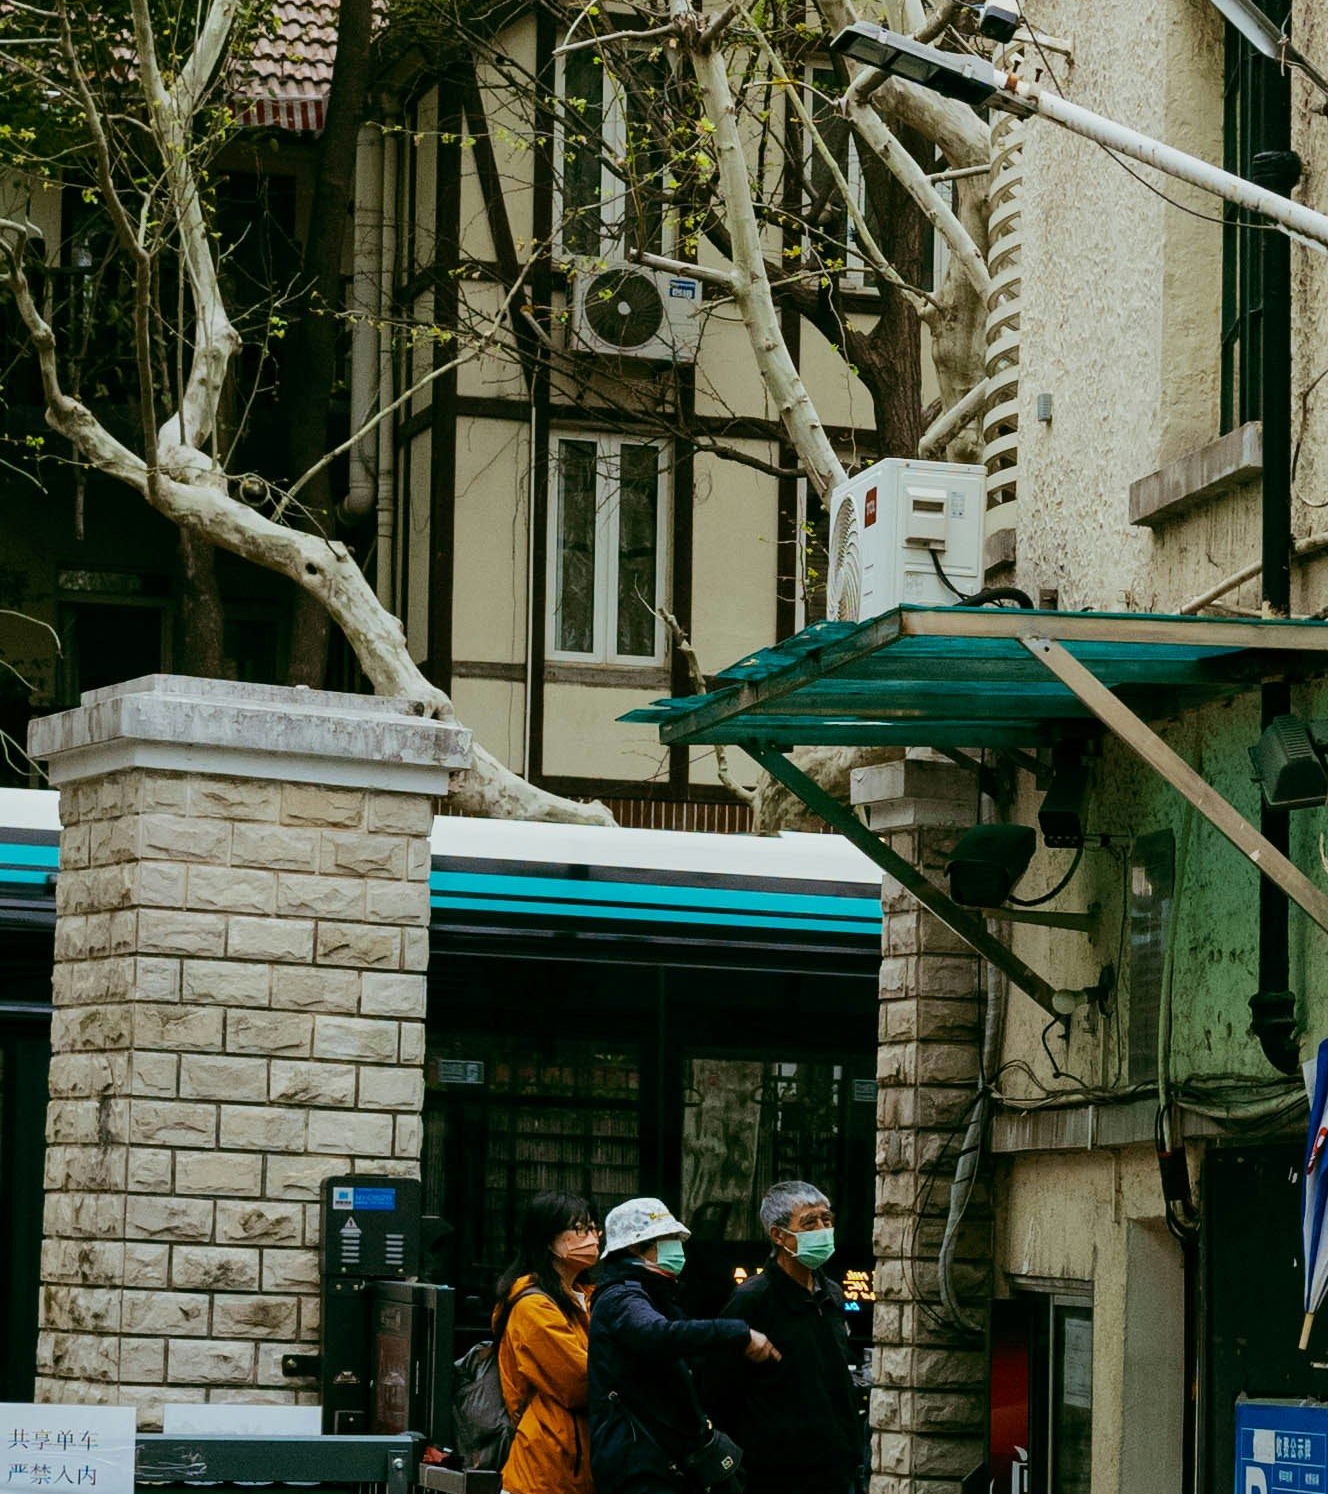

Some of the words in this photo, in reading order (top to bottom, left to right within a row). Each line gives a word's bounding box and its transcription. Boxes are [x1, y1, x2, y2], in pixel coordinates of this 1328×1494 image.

[7, 1428, 99, 1452] 共享单车
[7, 1464, 97, 1486] 严禁入内
